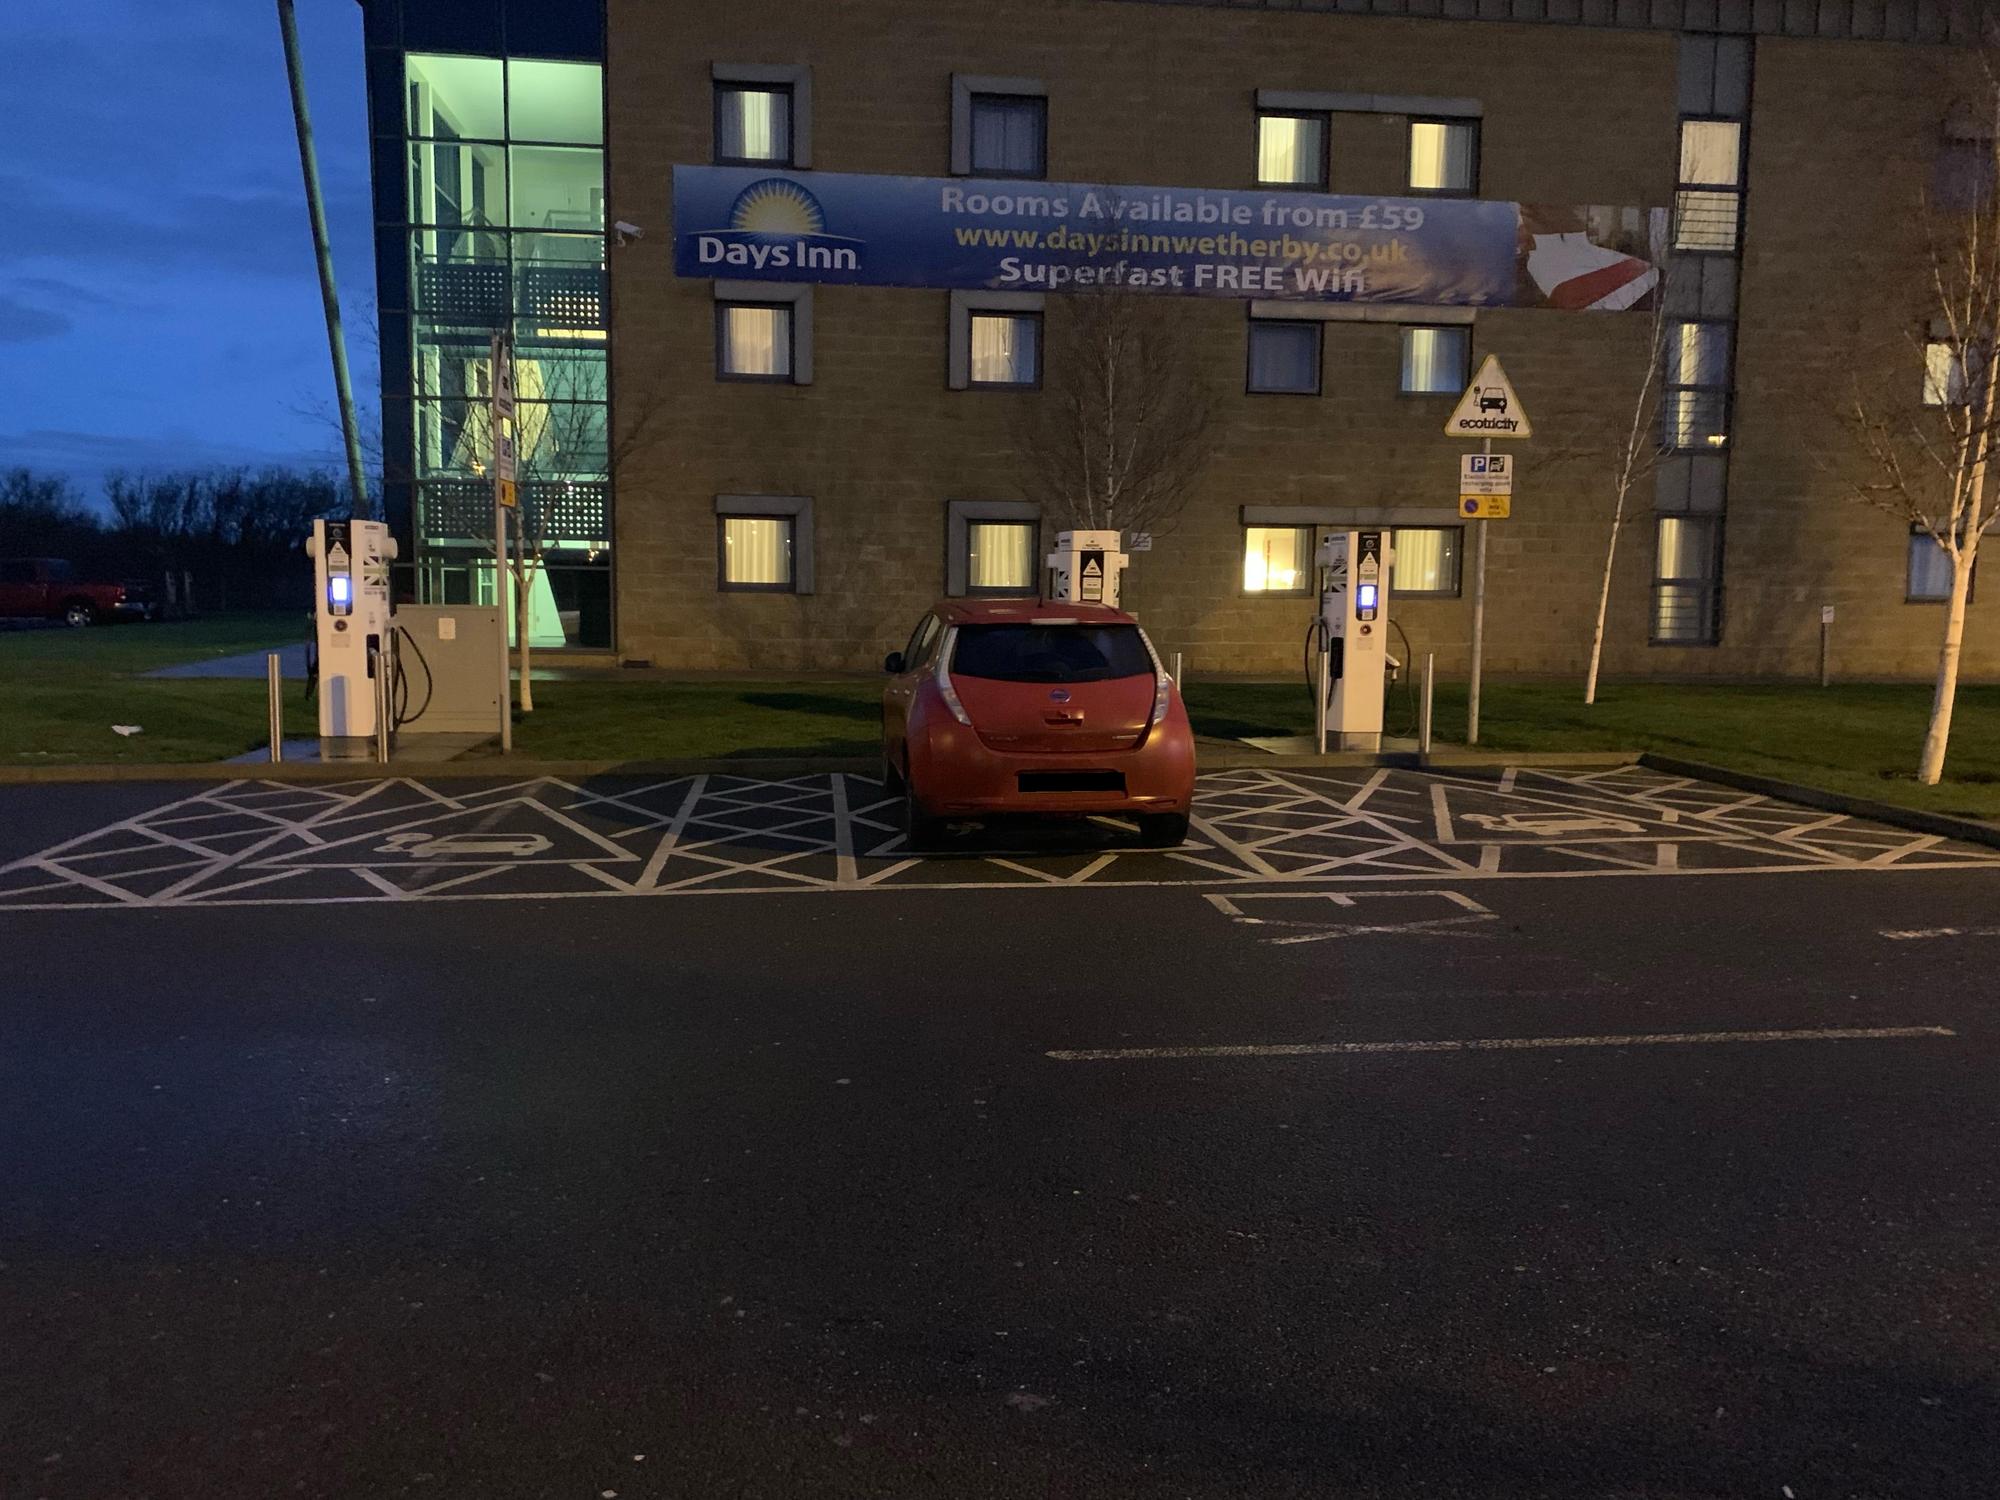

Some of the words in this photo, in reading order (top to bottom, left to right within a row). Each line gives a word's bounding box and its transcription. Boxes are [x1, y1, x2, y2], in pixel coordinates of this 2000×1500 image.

[941, 187, 1070, 218] Rooms
[1079, 192, 1253, 224] Available
[1262, 200, 1348, 229] from
[1360, 204, 1425, 231] £59
[698, 236, 790, 269] Days
[797, 241, 857, 270] Inn
[954, 225, 1409, 265] www.daysinnwetherby.co.uk
[1000, 256, 1184, 289] Superfast
[1194, 264, 1284, 291] FREE
[1295, 267, 1366, 293] Wifi
[1459, 417, 1519, 432] ecotricity
[1474, 457, 1485, 472] P
